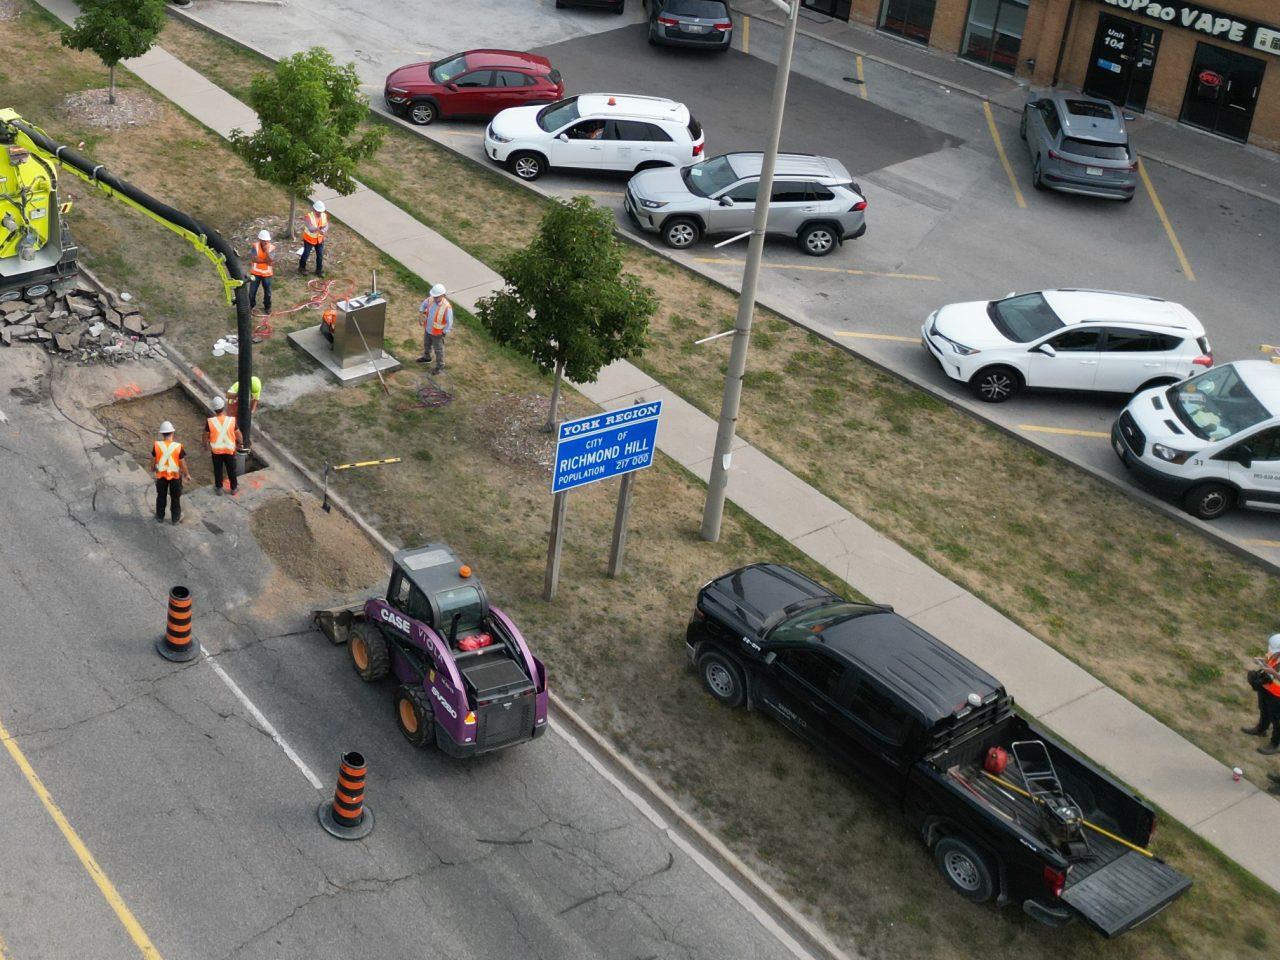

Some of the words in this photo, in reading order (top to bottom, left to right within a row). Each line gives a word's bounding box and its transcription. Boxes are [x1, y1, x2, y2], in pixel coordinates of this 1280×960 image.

[1107, 28, 1125, 40] Unit
[1180, 6, 1248, 43] VAPE
[1104, 36, 1125, 50] 104
[563, 419, 601, 436] YORK
[605, 405, 658, 425] REGION
[585, 437, 603, 449] CITY
[617, 430, 628, 441] OF
[558, 465, 605, 486] POPULATION
[615, 459, 630, 470] 217
[632, 453, 650, 466] 000
[559, 445, 620, 473] RICHMOND
[624, 438, 649, 456] HILL
[1193, 458, 1204, 466] 31
[380, 608, 411, 634] CASE
[418, 626, 444, 664] VIOLA
